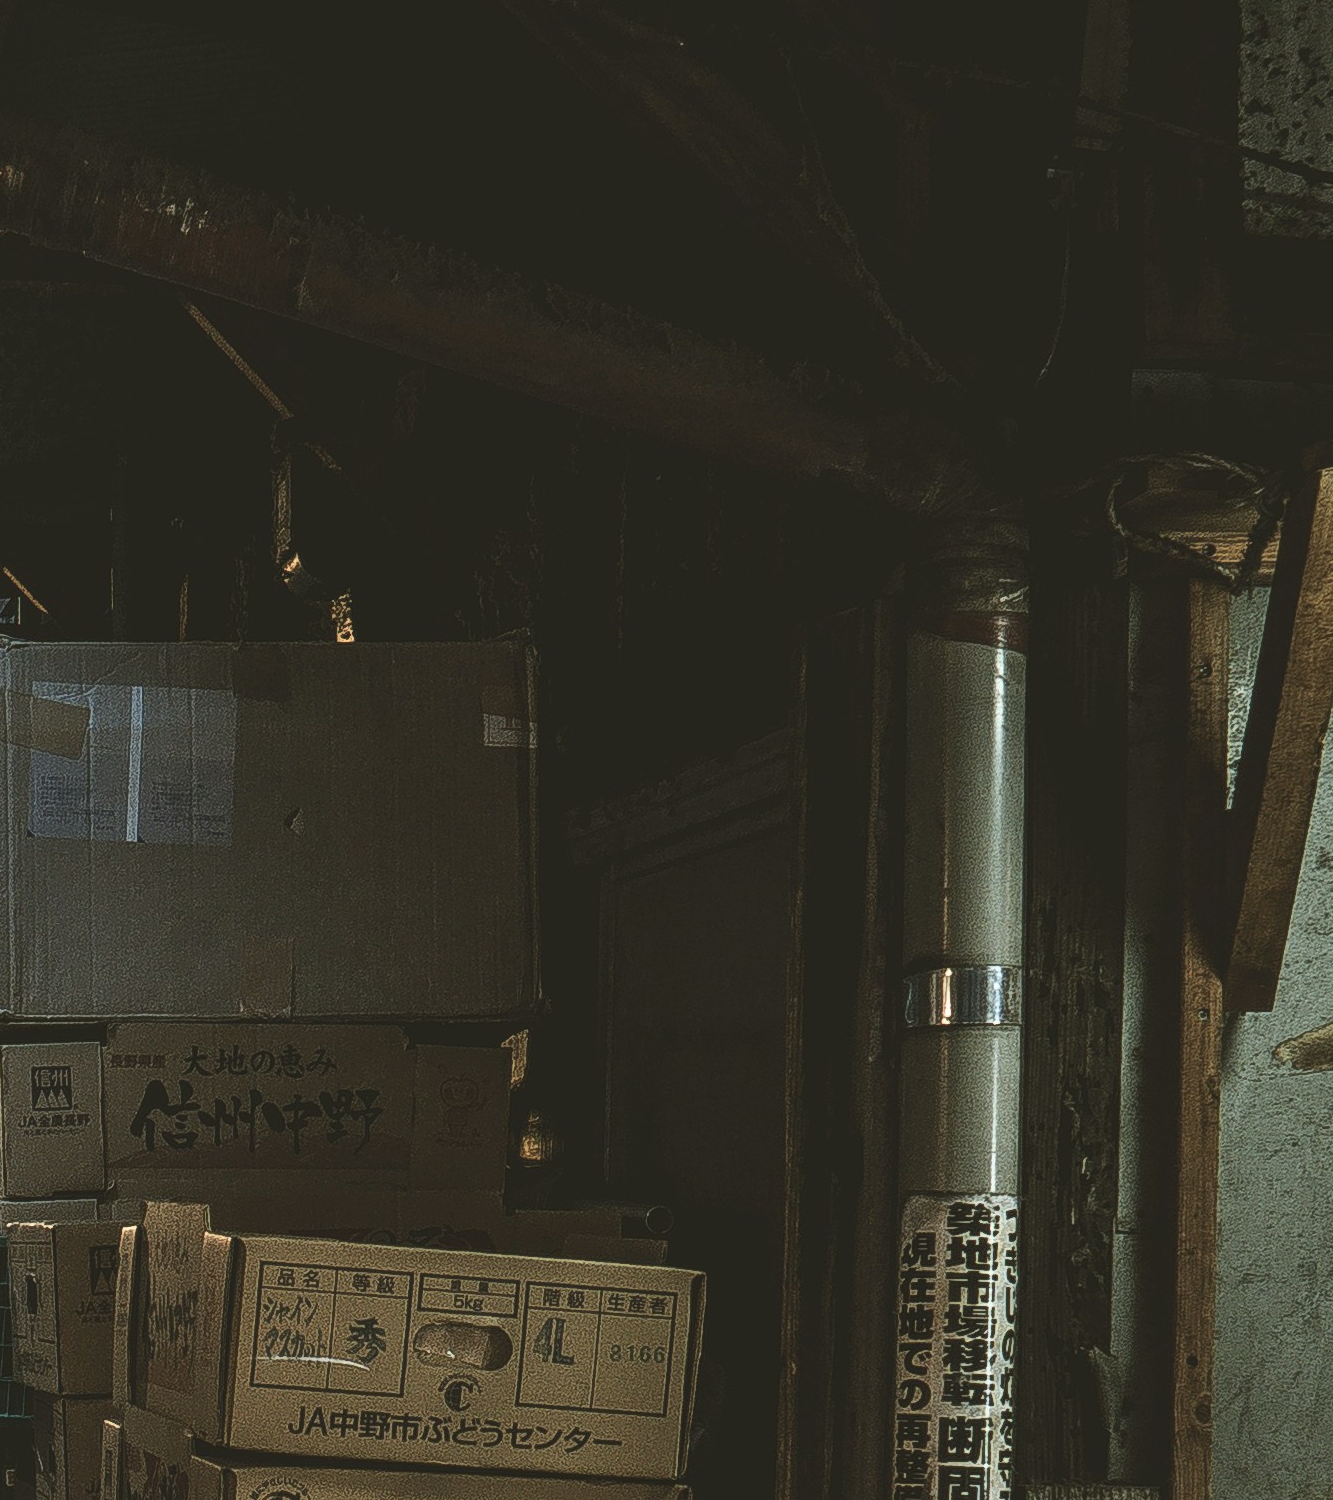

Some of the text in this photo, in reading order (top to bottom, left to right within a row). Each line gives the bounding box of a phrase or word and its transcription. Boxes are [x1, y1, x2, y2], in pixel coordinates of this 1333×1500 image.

[182, 1045, 337, 1078] 大地の恵み
[33, 1069, 70, 1088] 信州
[130, 1079, 383, 1155] 信州中野
[276, 1271, 321, 1289] 品名
[351, 1273, 395, 1295] 等級
[453, 1296, 485, 1313] 5kg
[542, 1288, 587, 1309] 階級
[608, 1295, 669, 1315] 生産者
[941, 1201, 1002, 1406] 築地市場移転
[347, 1317, 387, 1365] 秀
[532, 1316, 576, 1366] 4L
[288, 1406, 623, 1454] JA中野市ぶどうセンター
